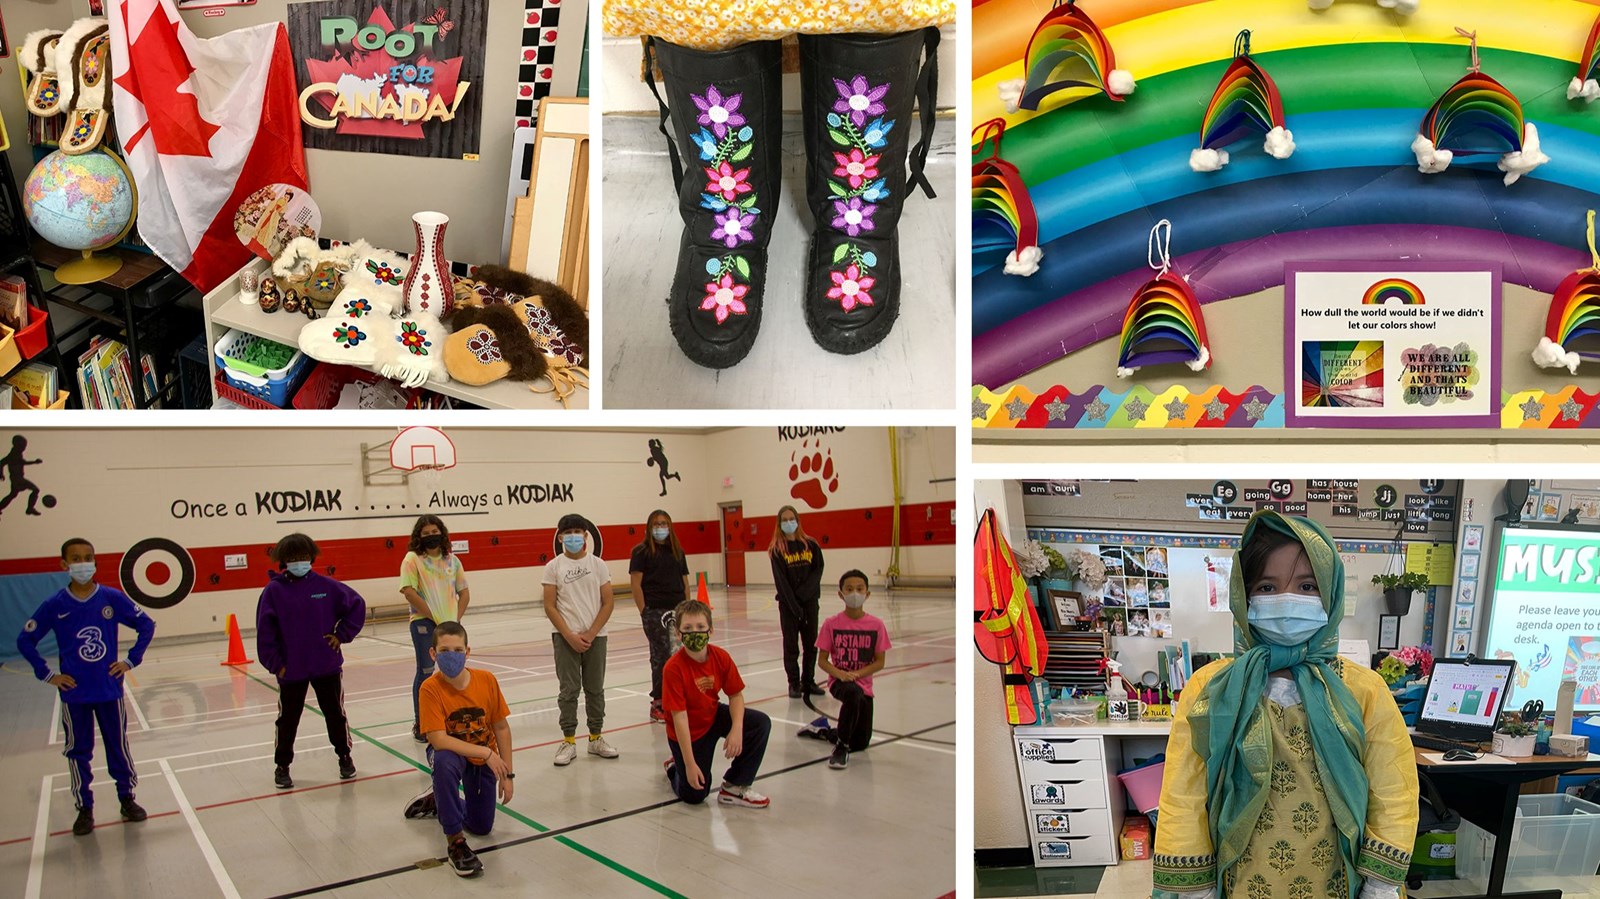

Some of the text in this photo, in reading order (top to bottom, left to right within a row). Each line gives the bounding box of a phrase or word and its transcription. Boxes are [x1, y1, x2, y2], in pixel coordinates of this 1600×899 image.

[321, 16, 440, 63] ROOT
[389, 63, 435, 83] FOR
[298, 81, 471, 129] CANADA!
[1301, 308, 1484, 317] How dull the world would be if we didn't
[1348, 321, 1436, 330] let our colors show!
[1408, 354, 1470, 362] WE ARE ALL
[1410, 364, 1468, 373] DIFFERENT
[1410, 376, 1468, 384] AND THATS
[1410, 386, 1468, 395] BEAUTIFUL
[1272, 481, 1291, 494] Gg
[1334, 480, 1358, 488] house
[1217, 486, 1234, 497] Ee
[1245, 491, 1270, 500] going
[1380, 490, 1392, 503] Jj
[171, 500, 228, 518] Once
[235, 502, 248, 516] a
[255, 489, 342, 515] KODIAK
[428, 490, 488, 511] Always
[494, 493, 502, 506] a
[507, 483, 574, 505] KODIAK
[1358, 510, 1400, 519] jump just
[1408, 508, 1450, 519] little long
[1501, 544, 1600, 585] MUS
[1518, 605, 1552, 615] Please
[1554, 606, 1580, 616] leave
[1516, 620, 1553, 631] agenda
[1556, 623, 1581, 632] open
[1584, 622, 1595, 630] to
[77, 626, 106, 662] 3
[835, 634, 871, 648] #STAND
[1514, 634, 1540, 644] desk.
[848, 648, 858, 662] TO
[1134, 841, 1143, 857] AHA
